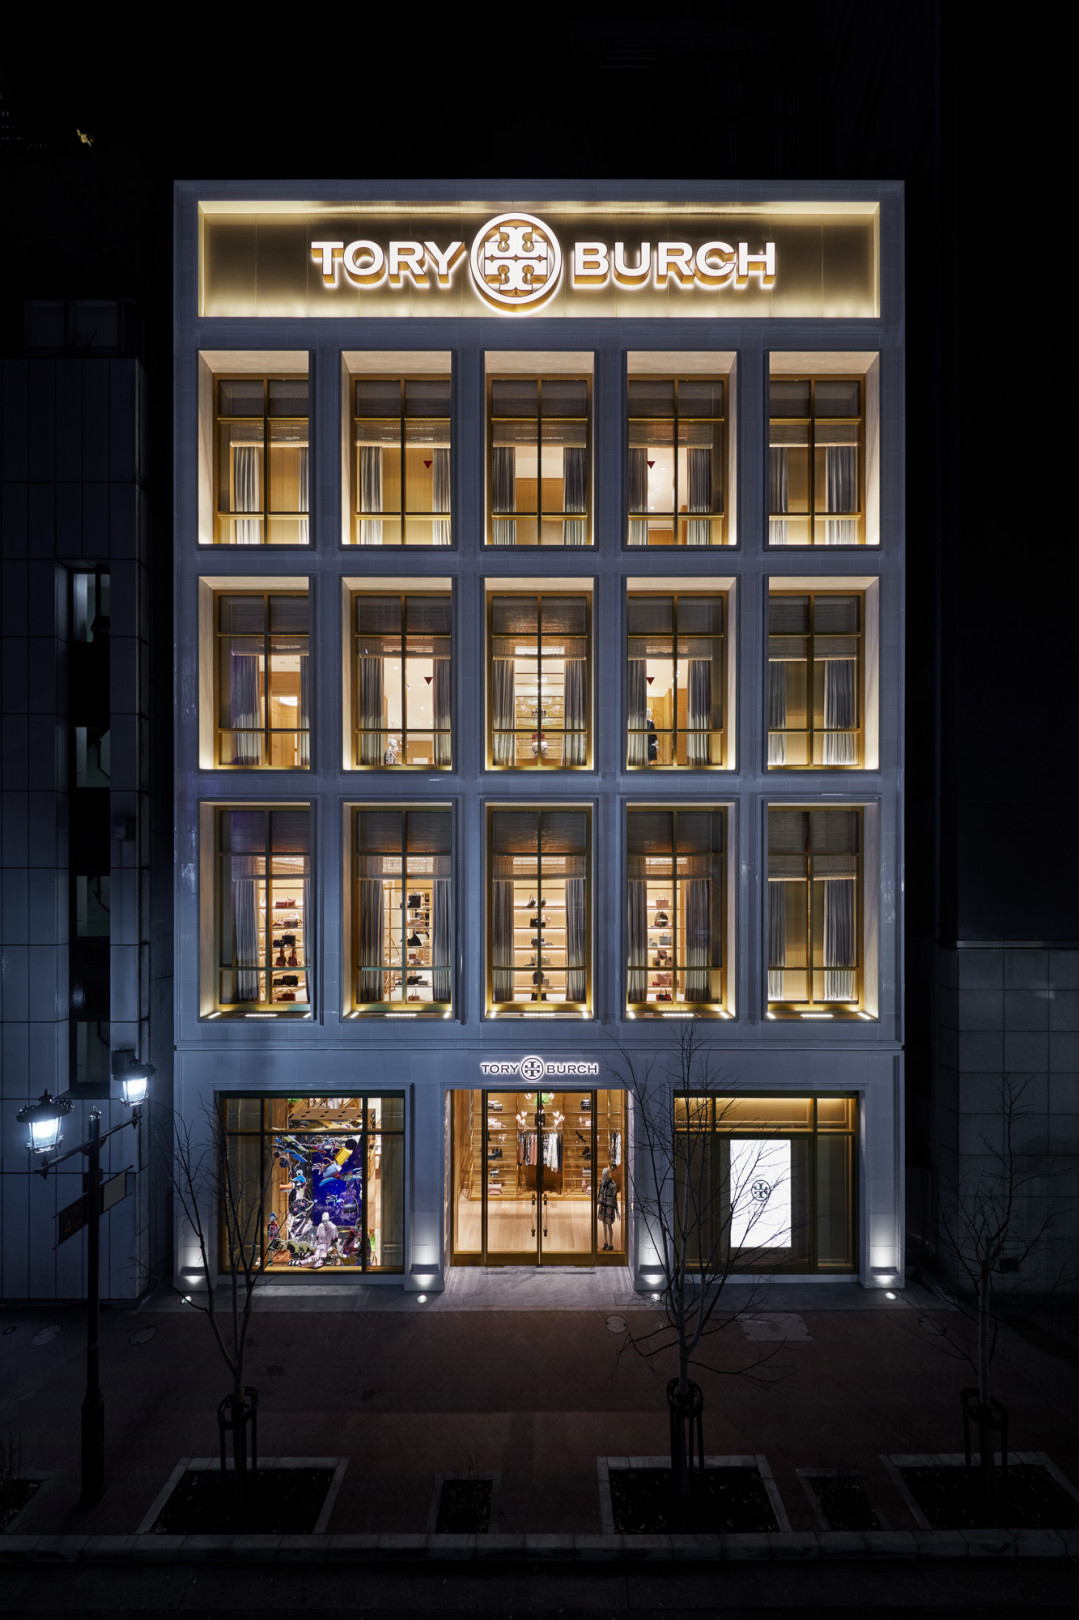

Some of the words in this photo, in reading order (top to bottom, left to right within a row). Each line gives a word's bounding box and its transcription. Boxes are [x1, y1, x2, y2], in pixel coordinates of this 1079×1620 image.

[311, 240, 463, 277] TORY
[574, 241, 776, 277] BURCH
[481, 1064, 519, 1074] TORY
[546, 1064, 598, 1074] BURCH
